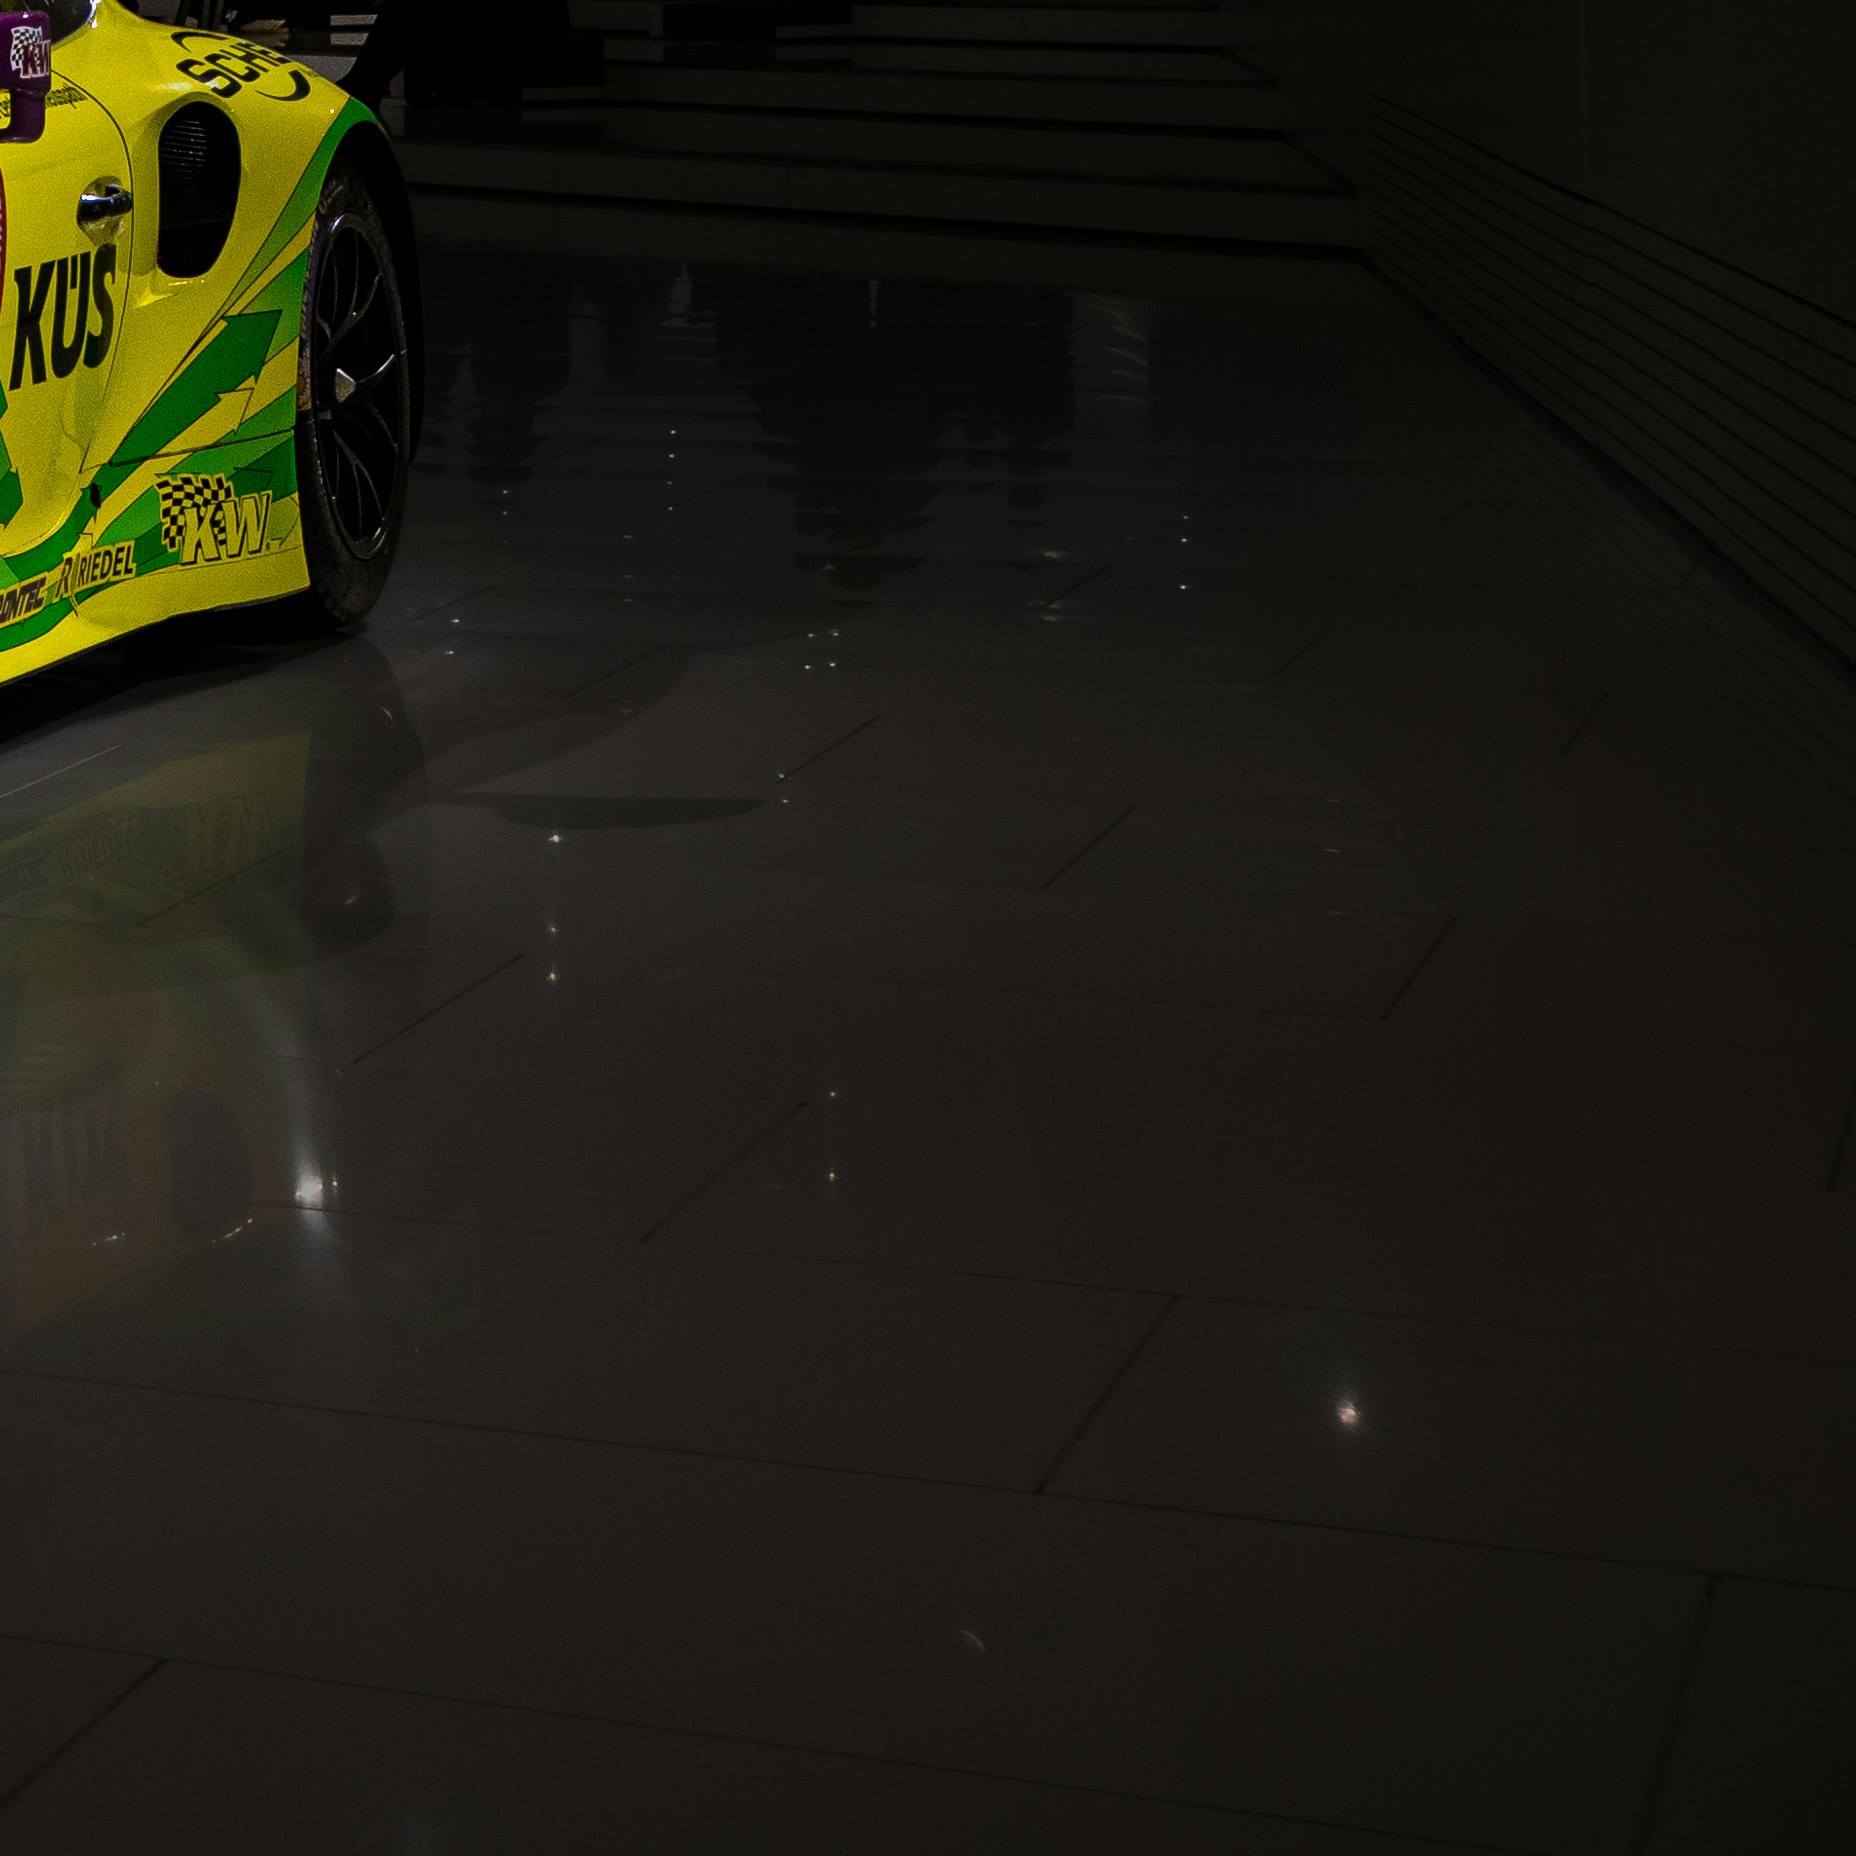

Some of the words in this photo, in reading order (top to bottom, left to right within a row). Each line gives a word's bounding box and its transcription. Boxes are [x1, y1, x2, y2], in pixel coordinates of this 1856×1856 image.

[8, 244, 117, 392] KÜS
[76, 545, 136, 587] RIEDEL
[180, 492, 272, 566] KW
